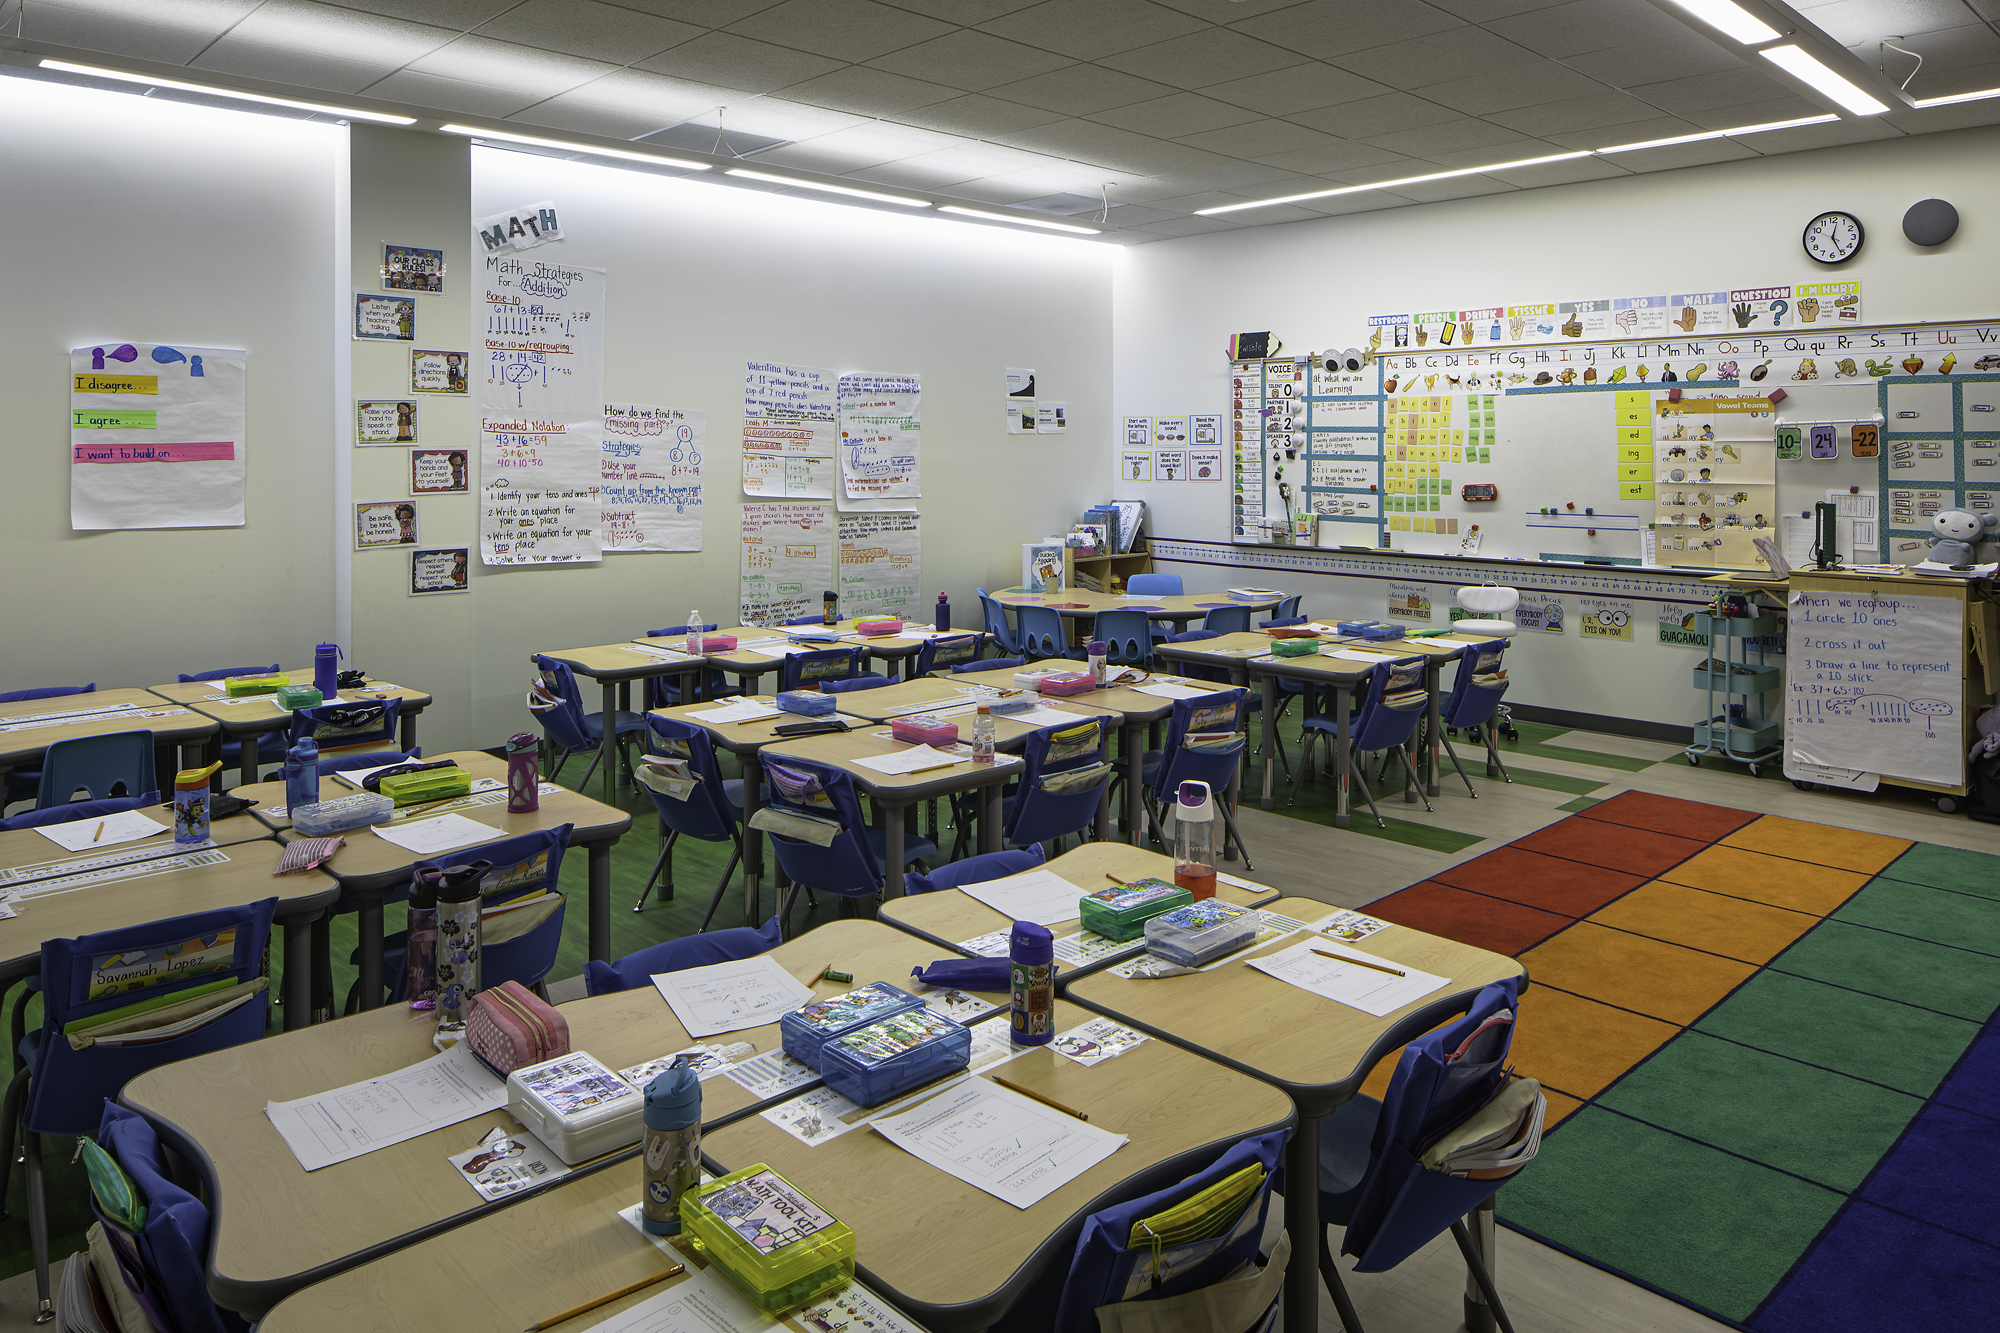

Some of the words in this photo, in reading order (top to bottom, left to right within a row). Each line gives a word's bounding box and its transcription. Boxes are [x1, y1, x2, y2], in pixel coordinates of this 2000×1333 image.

[1829, 216, 1838, 224] 12
[480, 208, 558, 251] MATH
[1810, 235, 1816, 243] 9
[393, 256, 410, 265] OUR
[411, 257, 434, 267] CLASS
[402, 264, 426, 273] RULES!
[486, 256, 523, 275] Math
[533, 262, 584, 286] Strategies
[524, 277, 563, 295] Addition
[1799, 286, 1817, 296] I'M
[1822, 283, 1856, 294] HURT
[1682, 295, 1715, 306] WAIT
[1731, 288, 1789, 302] QUESTION
[1573, 302, 1595, 313] YES
[1630, 298, 1649, 309] NO
[382, 311, 397, 319] your
[1466, 309, 1497, 321] DRINK
[1513, 305, 1548, 316] TISSUE
[365, 316, 390, 324] teacher
[1369, 316, 1409, 326] RESTROOM
[1418, 312, 1452, 323] PENCIL
[419, 368, 447, 376] directions
[747, 362, 782, 374] Valentina
[785, 367, 798, 377] has
[808, 372, 820, 383] cup
[1268, 365, 1292, 374] VOICE
[1312, 375, 1321, 383] at
[1342, 375, 1351, 383] we
[75, 377, 85, 389] I
[88, 377, 147, 393] disagree...
[1284, 384, 1292, 397] 0
[1318, 385, 1353, 395] Learning
[605, 405, 625, 417] How
[629, 405, 638, 417] do
[640, 410, 652, 419] we
[655, 406, 670, 419] find
[672, 410, 684, 420] the
[1286, 401, 1290, 413] 1
[75, 413, 84, 425] I
[1284, 418, 1292, 430] 2
[482, 418, 527, 432] Expanded
[609, 420, 639, 431] missing
[1629, 430, 1640, 439] ed
[1284, 435, 1292, 447] 3
[1815, 434, 1832, 449] 24
[75, 447, 84, 458] I
[87, 448, 115, 459] want
[120, 448, 131, 458] to
[133, 448, 155, 458] build
[1627, 449, 1640, 460] ing
[1630, 485, 1642, 494] est
[1795, 595, 1830, 608] When
[1839, 598, 1852, 608] we
[1389, 607, 1413, 616] EVERYBODY
[1413, 610, 1431, 619] FREEZE!
[1515, 610, 1543, 619] EVERYBODY
[1521, 618, 1540, 627] FOCUS!
[1816, 613, 1846, 624] circle
[1852, 612, 1868, 624] 10
[1873, 617, 1898, 627] ones
[1584, 625, 1597, 634] EYES
[1598, 627, 1607, 635] ON
[1609, 627, 1621, 636] YOU!
[1815, 640, 1847, 650] cross
[1853, 640, 1862, 650] it
[1868, 640, 1887, 651] out
[1816, 659, 1843, 669] Draw
[1849, 661, 1857, 669] a
[1862, 660, 1880, 671] line
[1885, 661, 1898, 671] to
[1902, 661, 1951, 674] represent
[1828, 672, 1842, 681] 10
[1847, 671, 1874, 683] stick
[96, 963, 157, 985] Savannah
[167, 956, 205, 973] Lopez
[745, 1178, 775, 1200] MATH
[770, 1198, 798, 1219] TOOL
[793, 1216, 818, 1233] KIT
